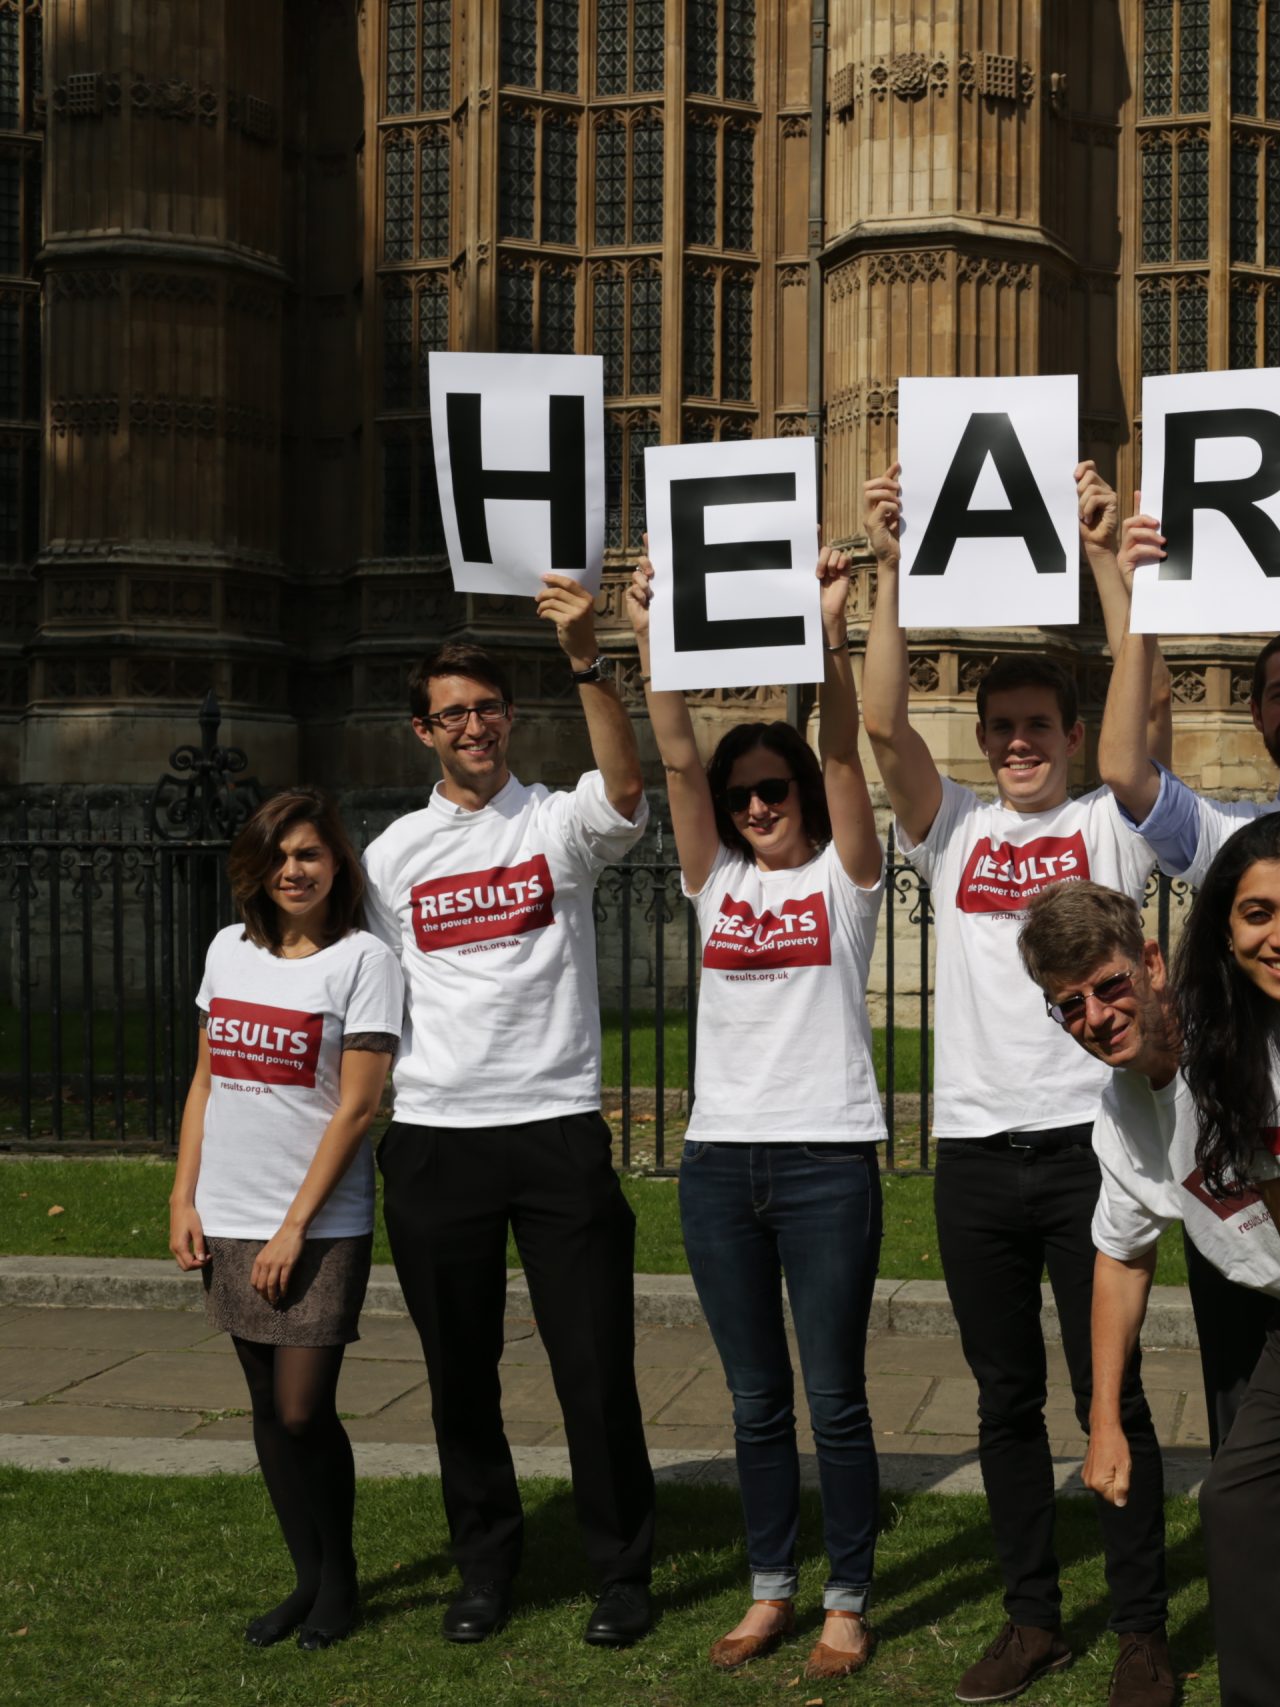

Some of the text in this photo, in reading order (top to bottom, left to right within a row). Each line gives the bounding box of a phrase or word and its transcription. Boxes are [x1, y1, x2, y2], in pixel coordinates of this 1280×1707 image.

[419, 874, 543, 920] RESULTS
[978, 883, 1008, 897] power
[1010, 888, 1021, 898] to
[1021, 884, 1040, 897] end
[422, 902, 545, 933] the power to end poverty
[458, 938, 521, 956] results.org.uk
[716, 940, 742, 951] power
[744, 946, 755, 954] to
[777, 936, 819, 950] poverty
[726, 971, 789, 982] results.org.uk
[212, 1047, 236, 1057] power
[238, 1050, 246, 1059] to
[246, 1052, 264, 1062] end
[266, 1055, 304, 1071] poverty
